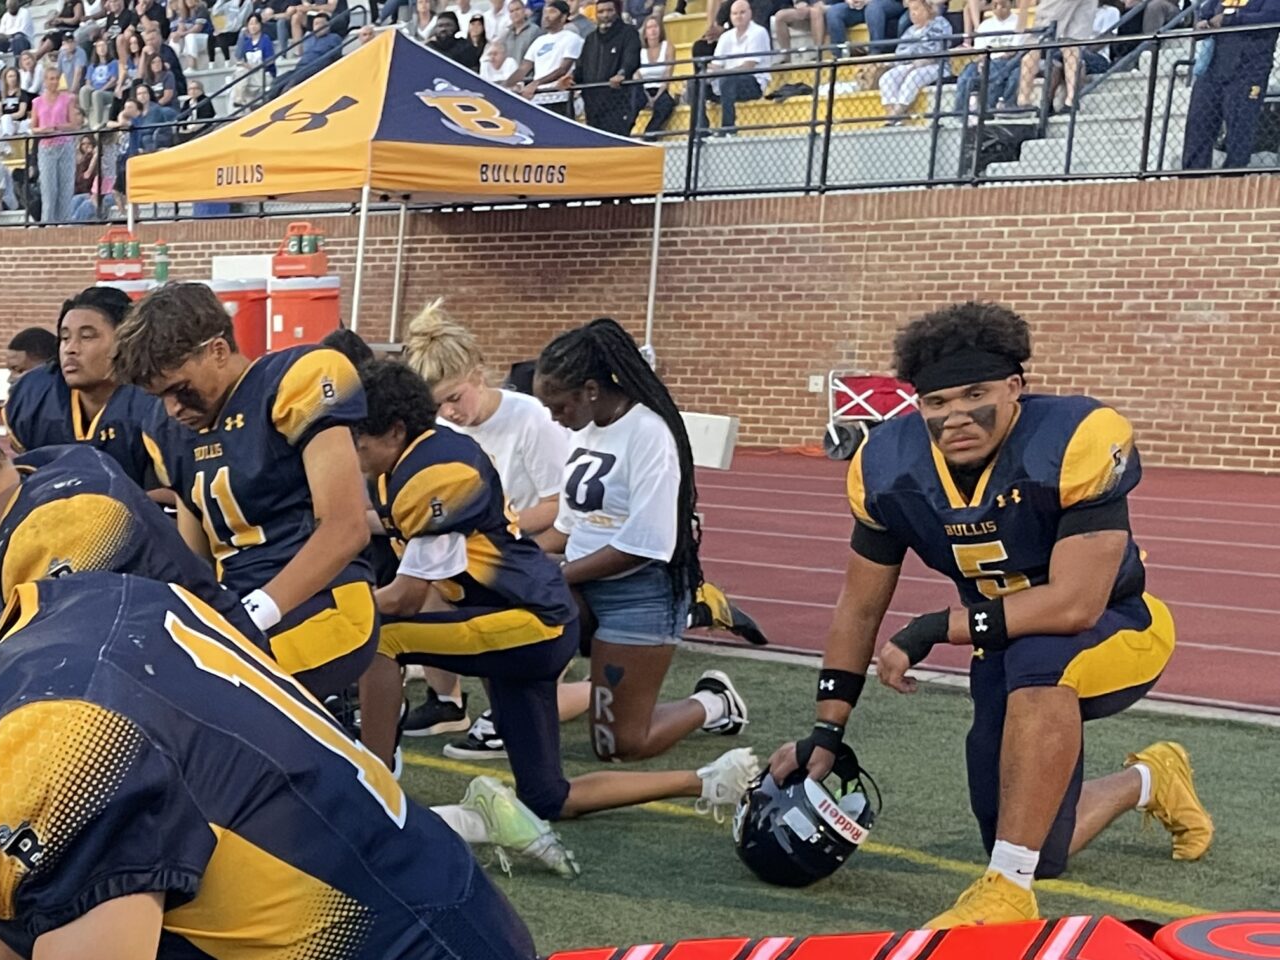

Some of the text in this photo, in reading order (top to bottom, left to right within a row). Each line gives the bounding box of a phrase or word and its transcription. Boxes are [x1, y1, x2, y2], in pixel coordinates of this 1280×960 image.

[417, 97, 517, 138] B
[216, 163, 265, 187] BULLIS
[479, 163, 568, 184] BULLDOGS
[191, 462, 266, 561] 11
[944, 520, 998, 539] BULLIS
[951, 539, 1031, 600] 5
[816, 798, 865, 844] Riddell
